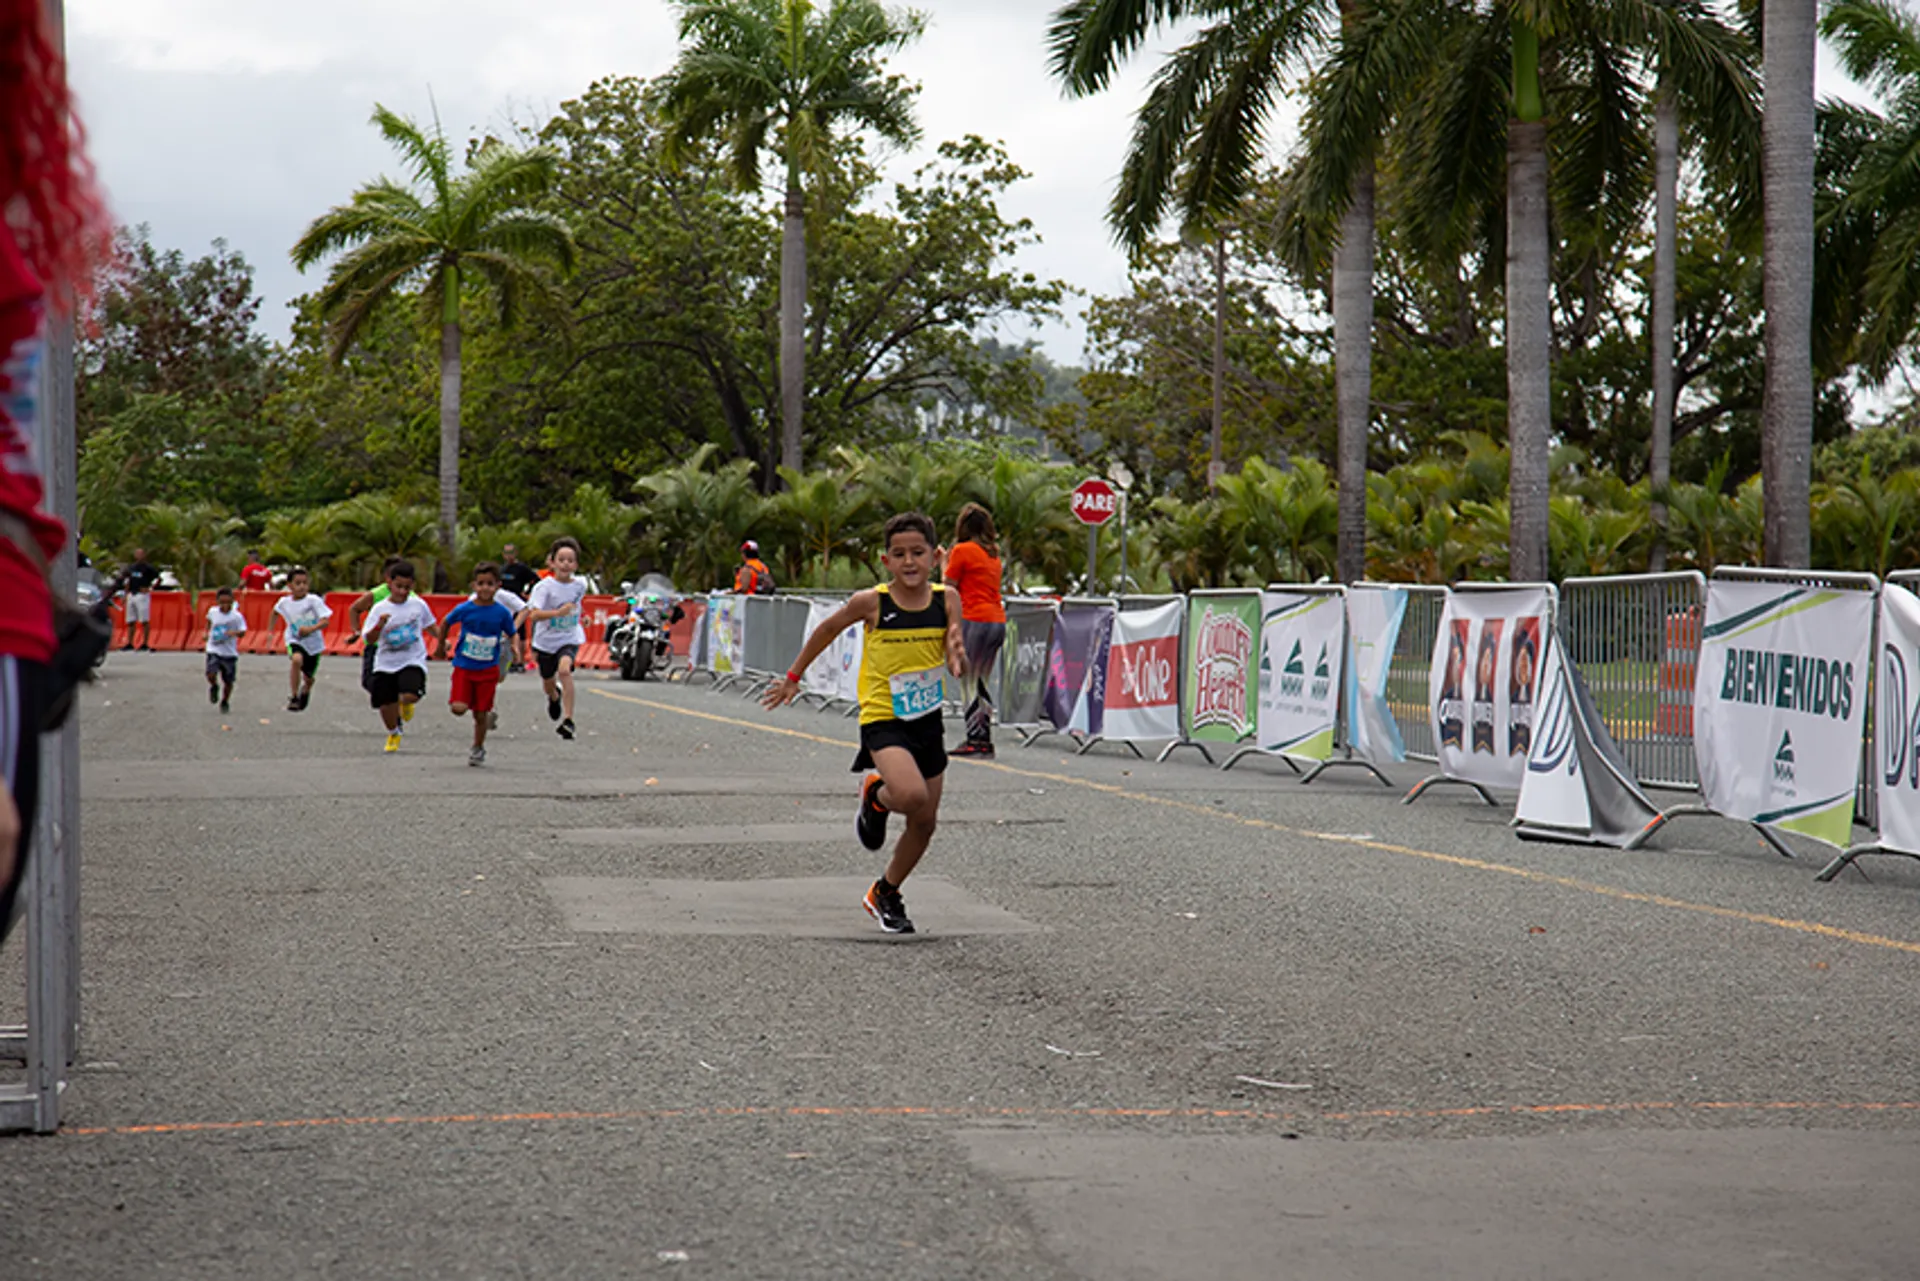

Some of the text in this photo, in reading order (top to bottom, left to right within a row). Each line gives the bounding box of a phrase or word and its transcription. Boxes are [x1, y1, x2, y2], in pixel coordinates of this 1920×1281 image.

[1074, 492, 1115, 511] PARE
[1134, 645, 1171, 703] Coke
[1195, 663, 1248, 728] Hearth
[1720, 648, 1854, 721] BIENVENIDOS
